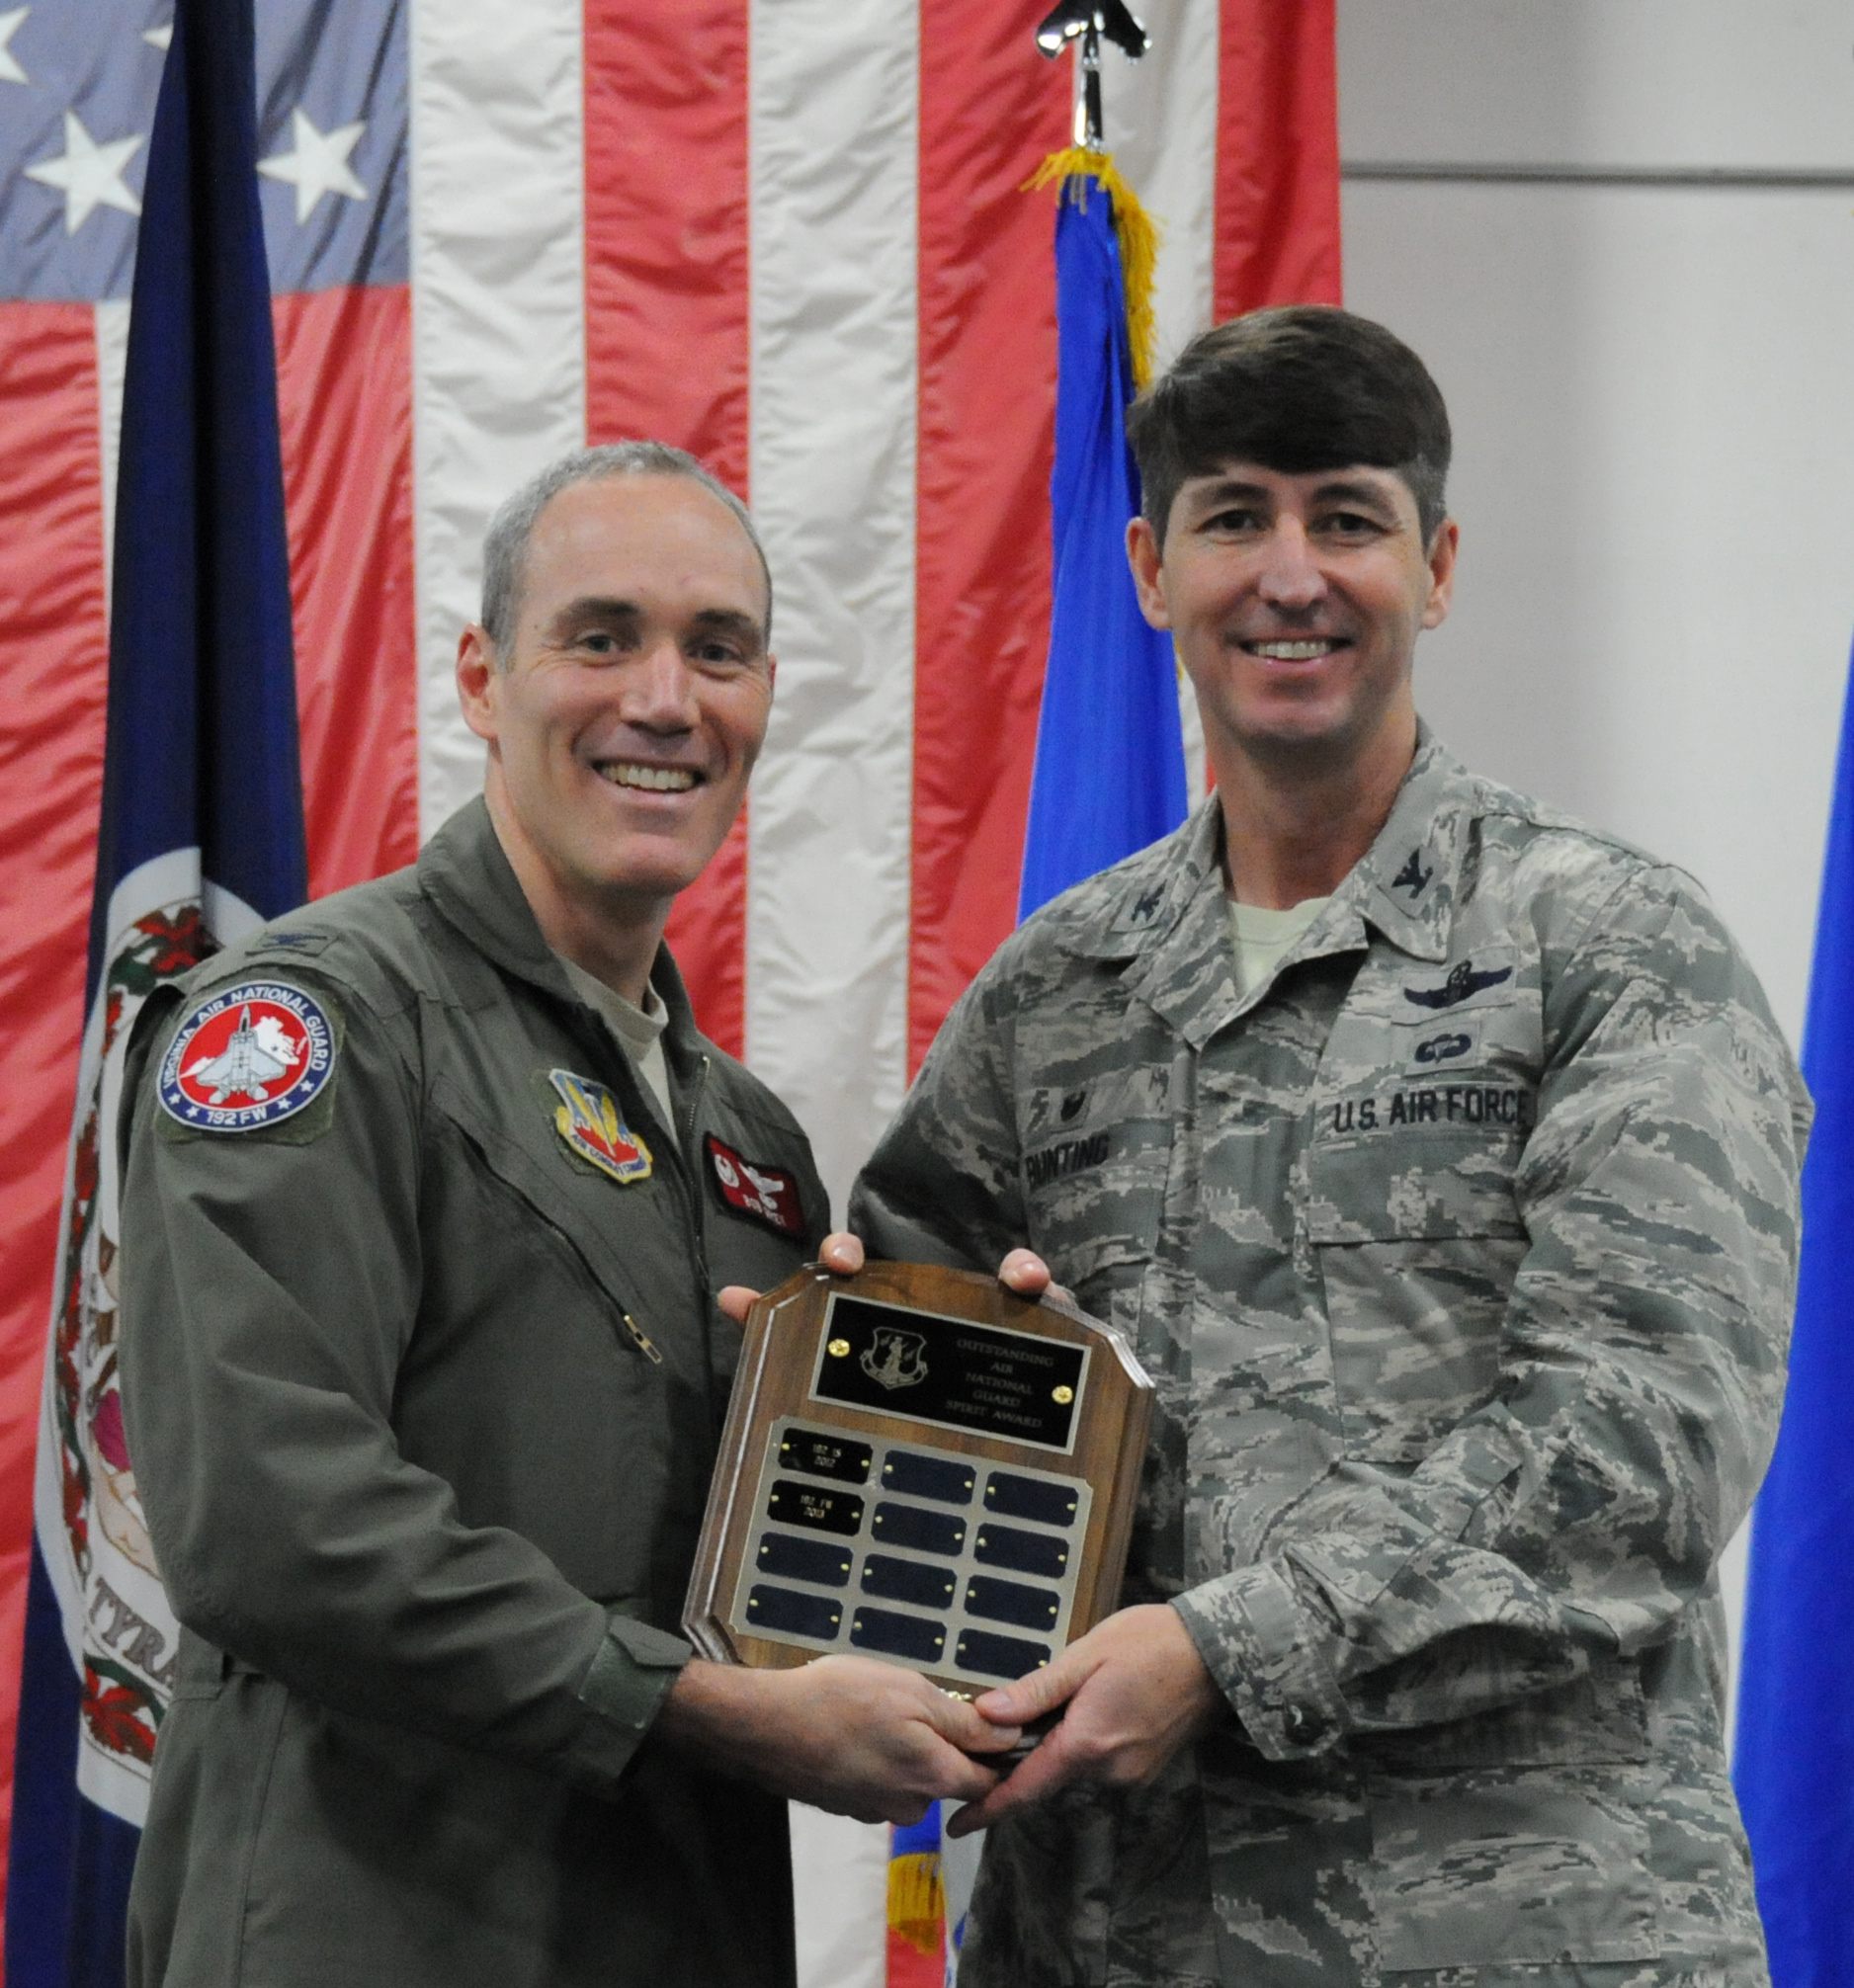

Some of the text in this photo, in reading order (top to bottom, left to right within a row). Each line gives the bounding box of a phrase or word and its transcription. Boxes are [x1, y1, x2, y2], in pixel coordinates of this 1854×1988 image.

[163, 986, 329, 1089] VIRGINIA AIR NATIONAL GUARD
[207, 1107, 269, 1125] 192 FW
[1334, 1088, 1530, 1133] U.S. AIR FORCE
[957, 1338, 1054, 1367] OUTSTANDING
[989, 1362, 1015, 1374] AIR
[965, 1371, 1034, 1395] NATIONAL
[971, 1389, 1022, 1408] GUARD
[945, 1399, 1044, 1429] SPIRIT AWARD
